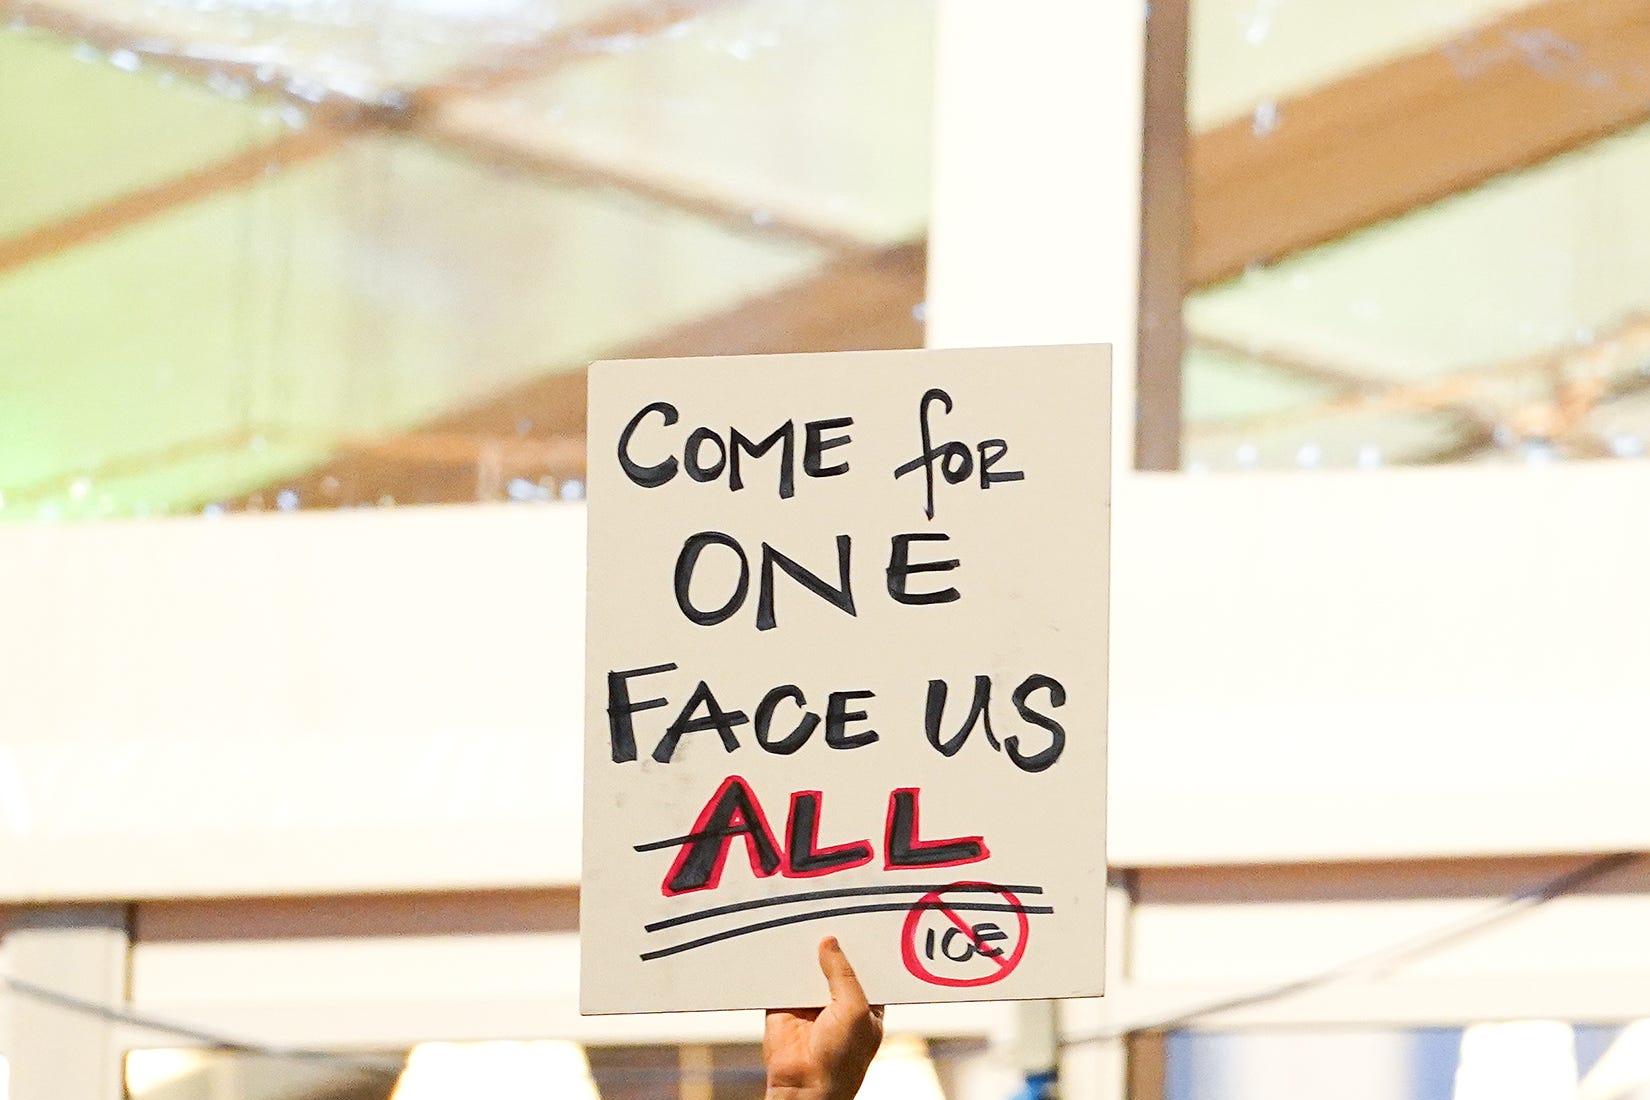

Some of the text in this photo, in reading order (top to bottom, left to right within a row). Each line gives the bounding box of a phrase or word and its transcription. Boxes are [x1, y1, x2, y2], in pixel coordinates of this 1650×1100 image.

[617, 400, 855, 500] COME
[673, 530, 961, 631] ONE
[606, 661, 1067, 773] FACE US
[633, 774, 990, 897] ALL
[925, 922, 1009, 963] ICE
